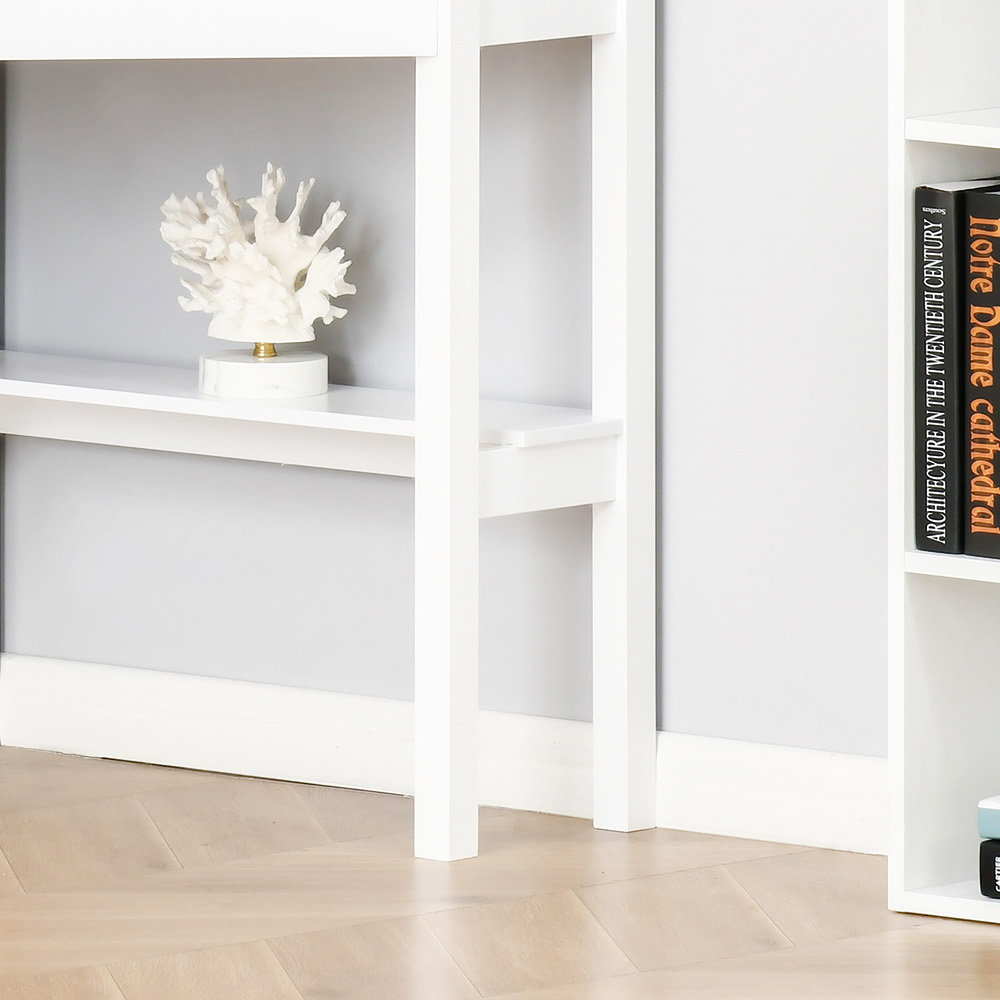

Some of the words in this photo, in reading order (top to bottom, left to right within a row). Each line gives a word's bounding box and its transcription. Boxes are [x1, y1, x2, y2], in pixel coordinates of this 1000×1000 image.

[923, 218, 945, 289] CENTURY
[924, 290, 945, 376] TWENTIETH
[970, 304, 1000, 388] Dame
[925, 378, 946, 408] THE
[926, 410, 946, 428] IN
[926, 430, 947, 544] ARCHITECYURE
[970, 398, 1000, 535] cathedral
